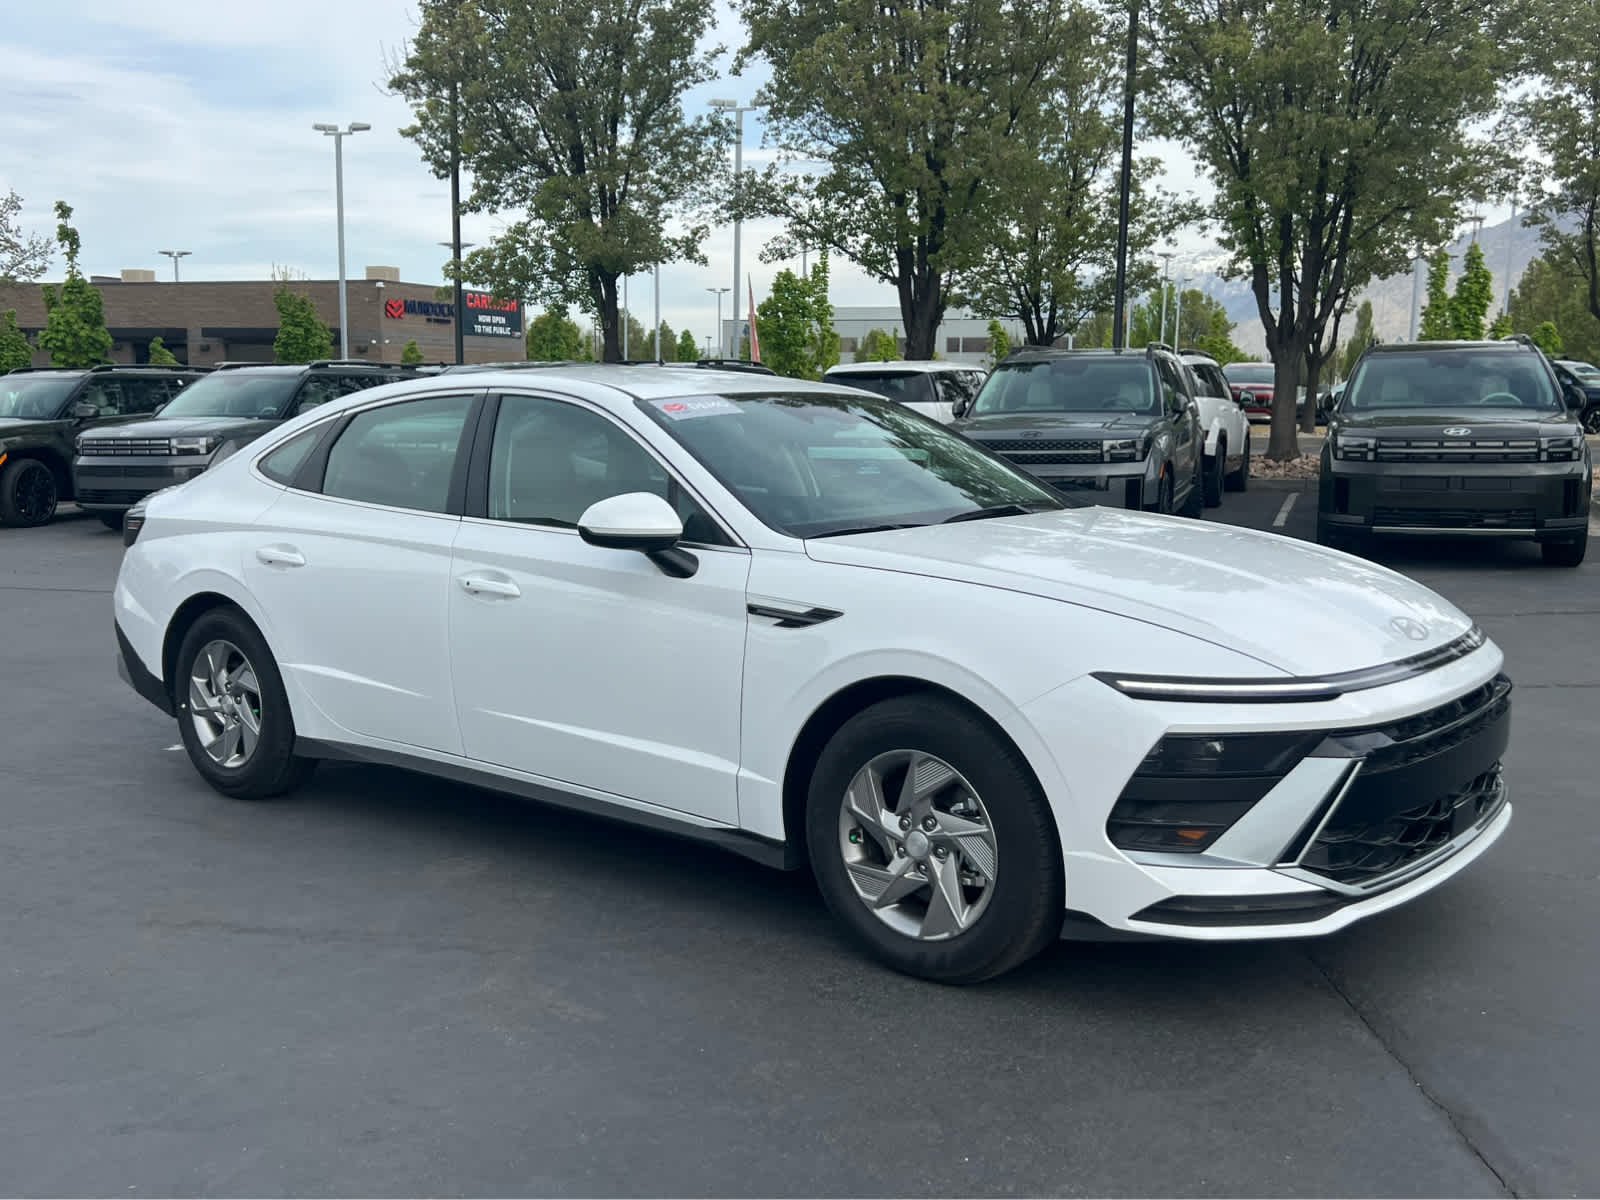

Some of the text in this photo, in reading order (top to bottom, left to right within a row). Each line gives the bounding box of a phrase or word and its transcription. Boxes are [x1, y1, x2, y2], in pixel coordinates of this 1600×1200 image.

[466, 293, 517, 312] CARWSH
[478, 314, 506, 325] NOW OPEN
[474, 324, 482, 333] TO
[482, 325, 492, 335] THE
[493, 326, 512, 336] PUBLIC
